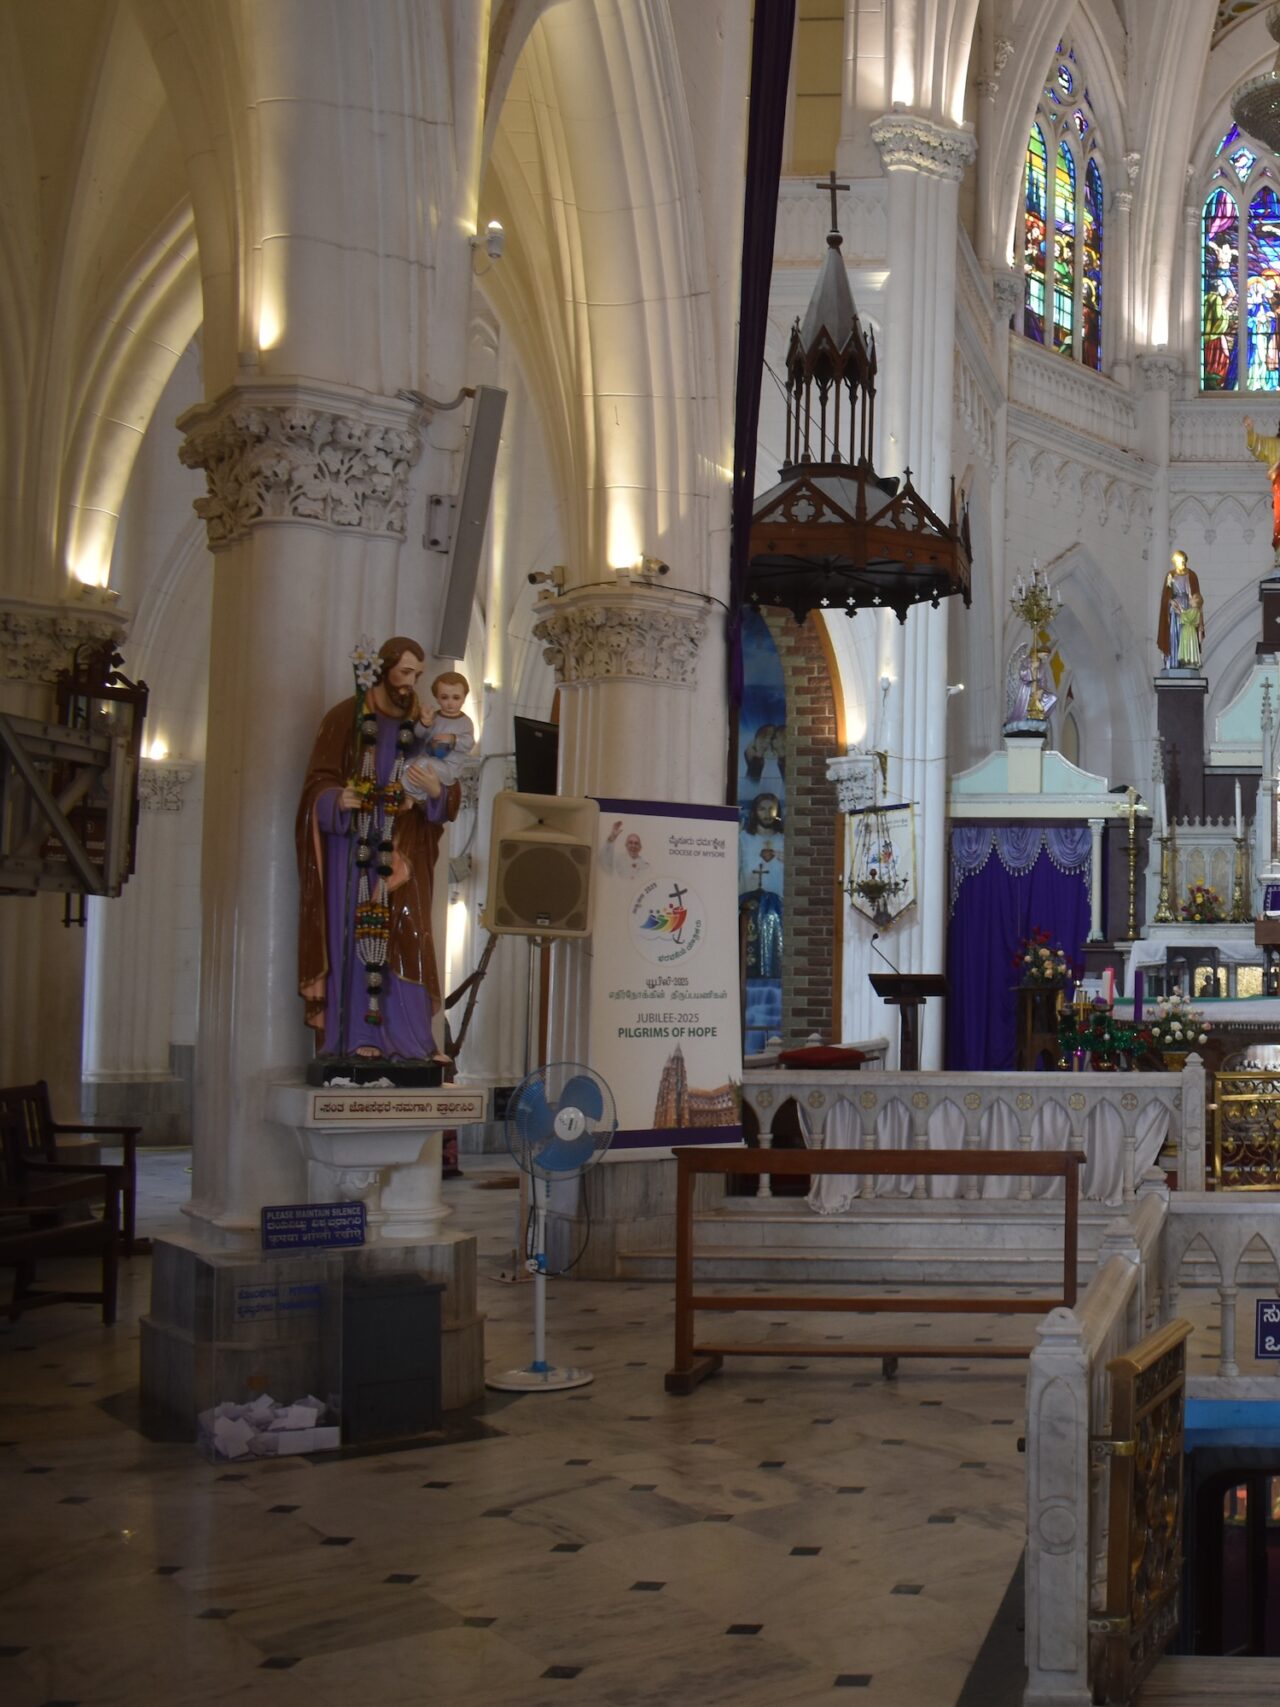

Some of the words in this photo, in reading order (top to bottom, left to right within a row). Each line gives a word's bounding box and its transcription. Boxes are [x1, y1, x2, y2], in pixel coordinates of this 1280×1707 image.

[669, 848, 693, 857] DIOCESE
[693, 849, 701, 857] OF
[702, 850, 725, 858] MYSORE
[636, 1013, 700, 1023] JUBILEE-2025
[618, 1027, 669, 1038] PILGRIMS
[671, 1027, 686, 1038] OF
[688, 1027, 718, 1037] HOPE
[267, 1211, 293, 1220] PLEASE
[295, 1209, 330, 1218] MAINTAIN
[332, 1207, 361, 1216] SILENCE
